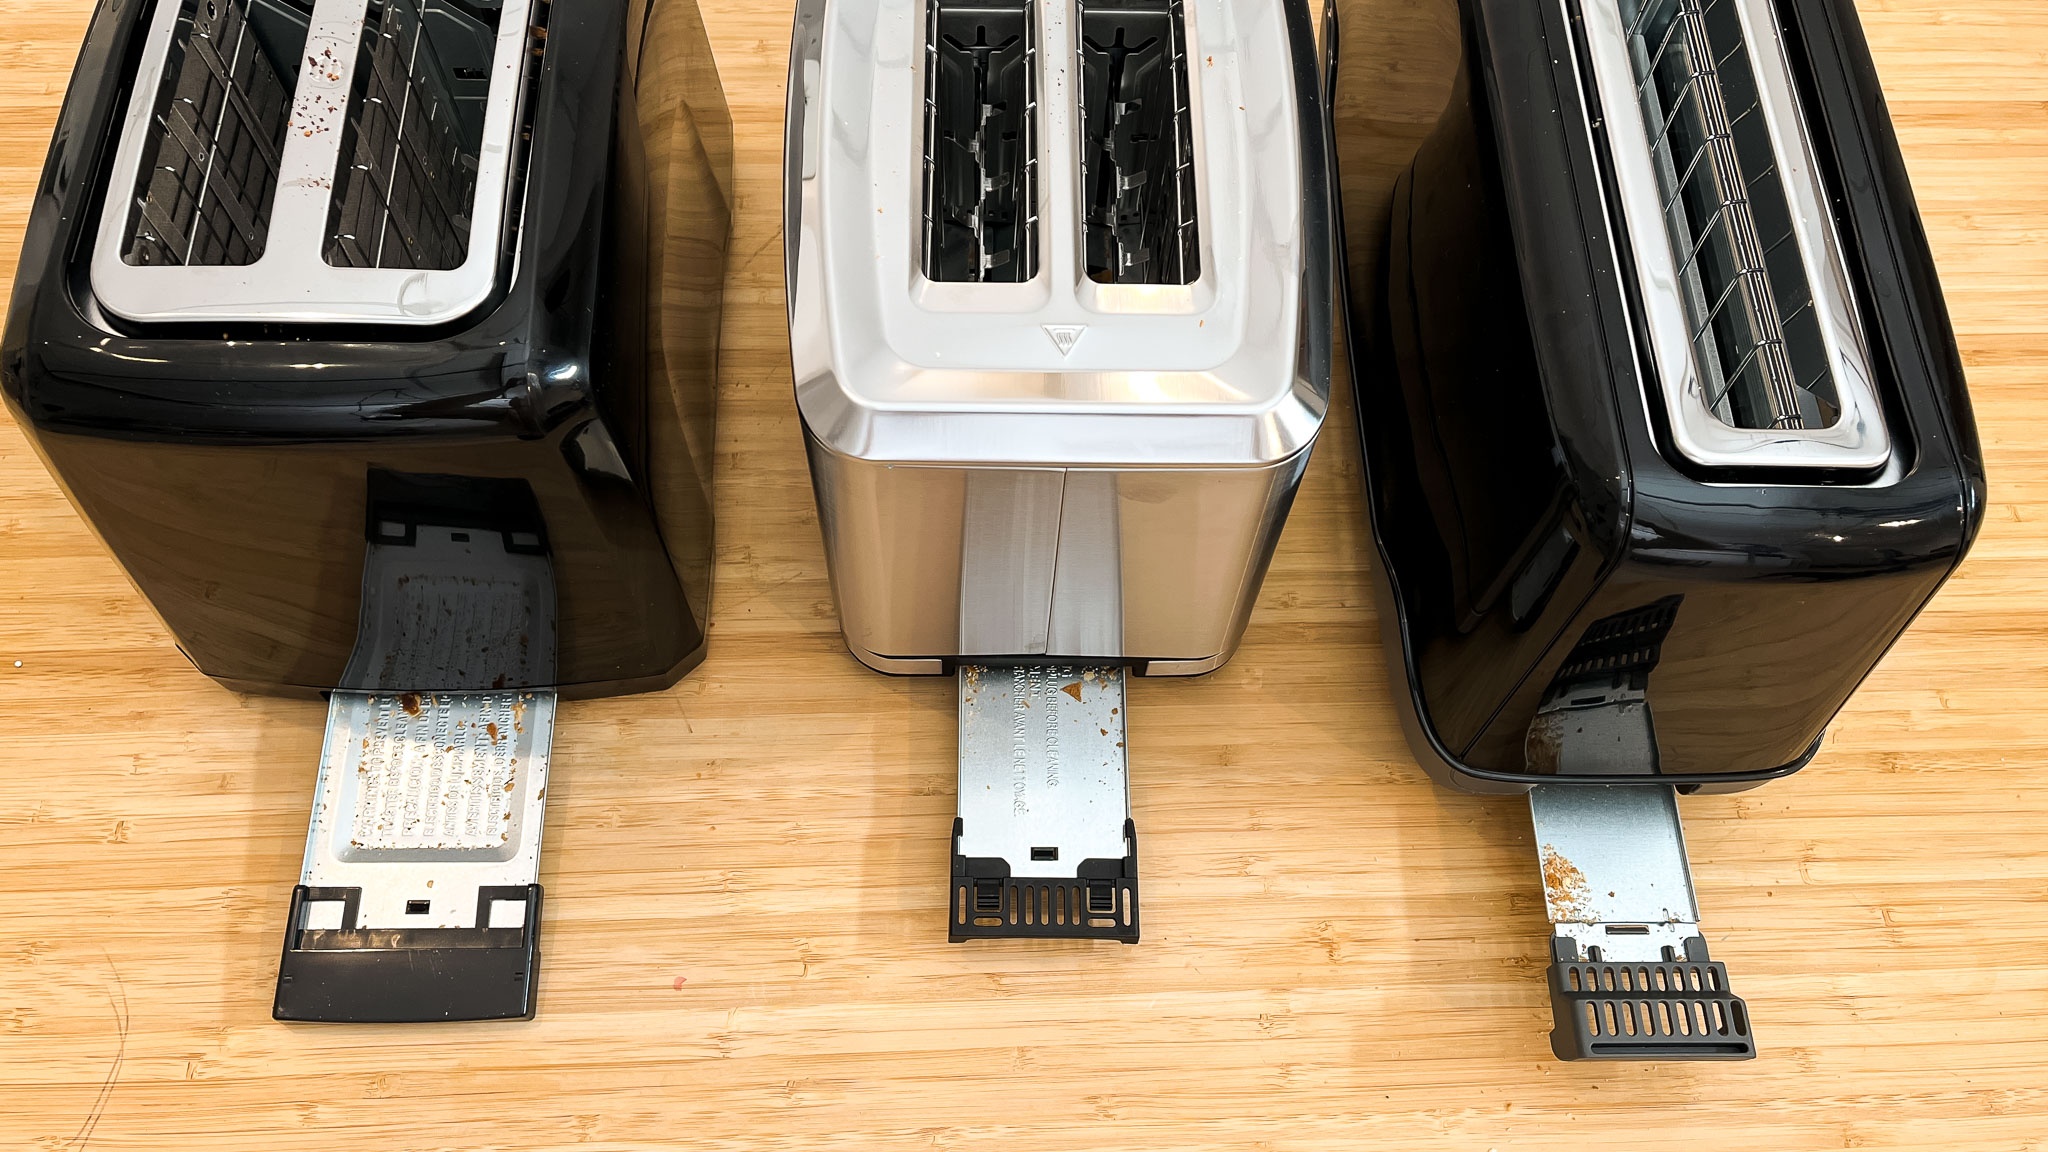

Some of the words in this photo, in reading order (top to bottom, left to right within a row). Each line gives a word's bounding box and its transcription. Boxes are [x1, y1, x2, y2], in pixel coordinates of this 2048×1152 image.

[372, 707, 389, 755] PREVENT
[1014, 713, 1025, 742] AVANT
[1046, 696, 1059, 737] BEFORE
[416, 726, 428, 744] FIN
[388, 745, 404, 786] BEFORE
[446, 784, 460, 800] DE
[443, 801, 457, 836] ANTES
